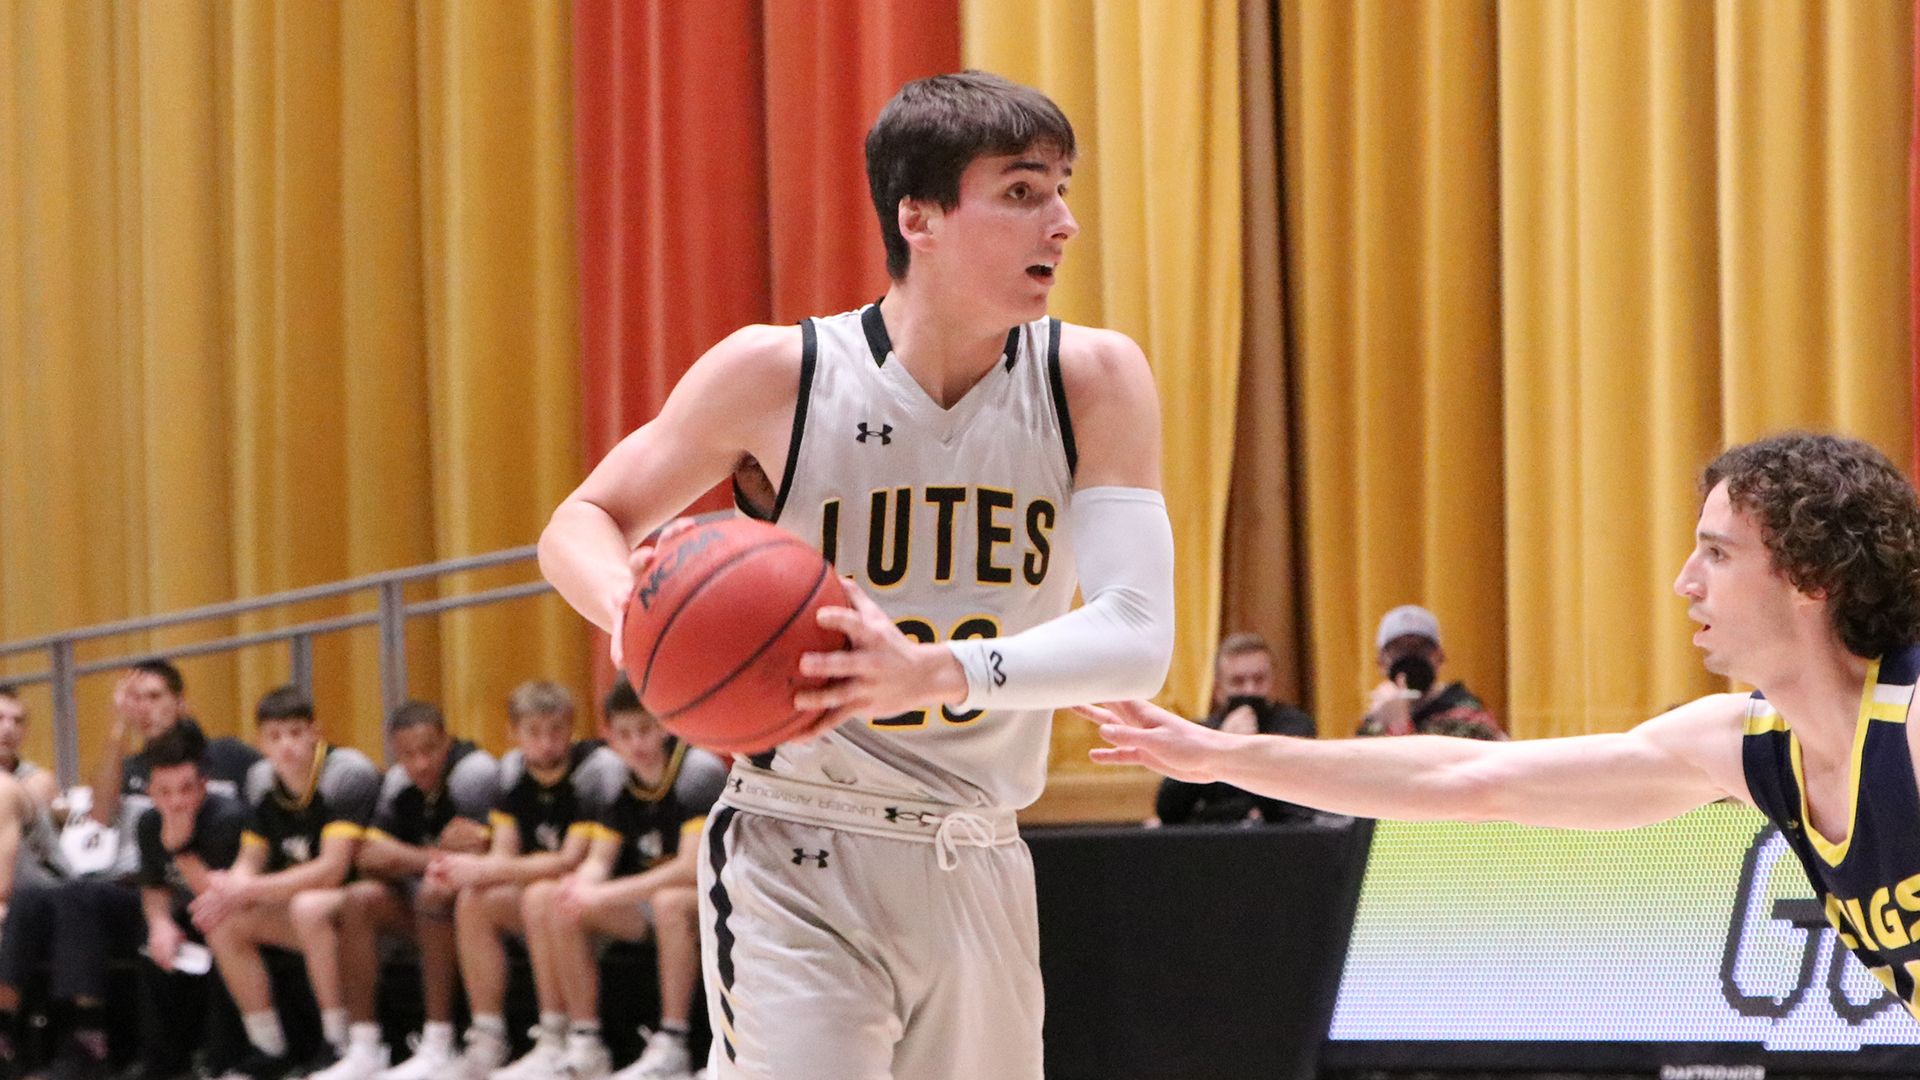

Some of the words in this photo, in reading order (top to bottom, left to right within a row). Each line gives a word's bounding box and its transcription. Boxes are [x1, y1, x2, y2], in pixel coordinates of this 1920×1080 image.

[639, 528, 726, 611] NCAA
[821, 483, 1057, 590] LUTES
[817, 799, 876, 818] UNDER
